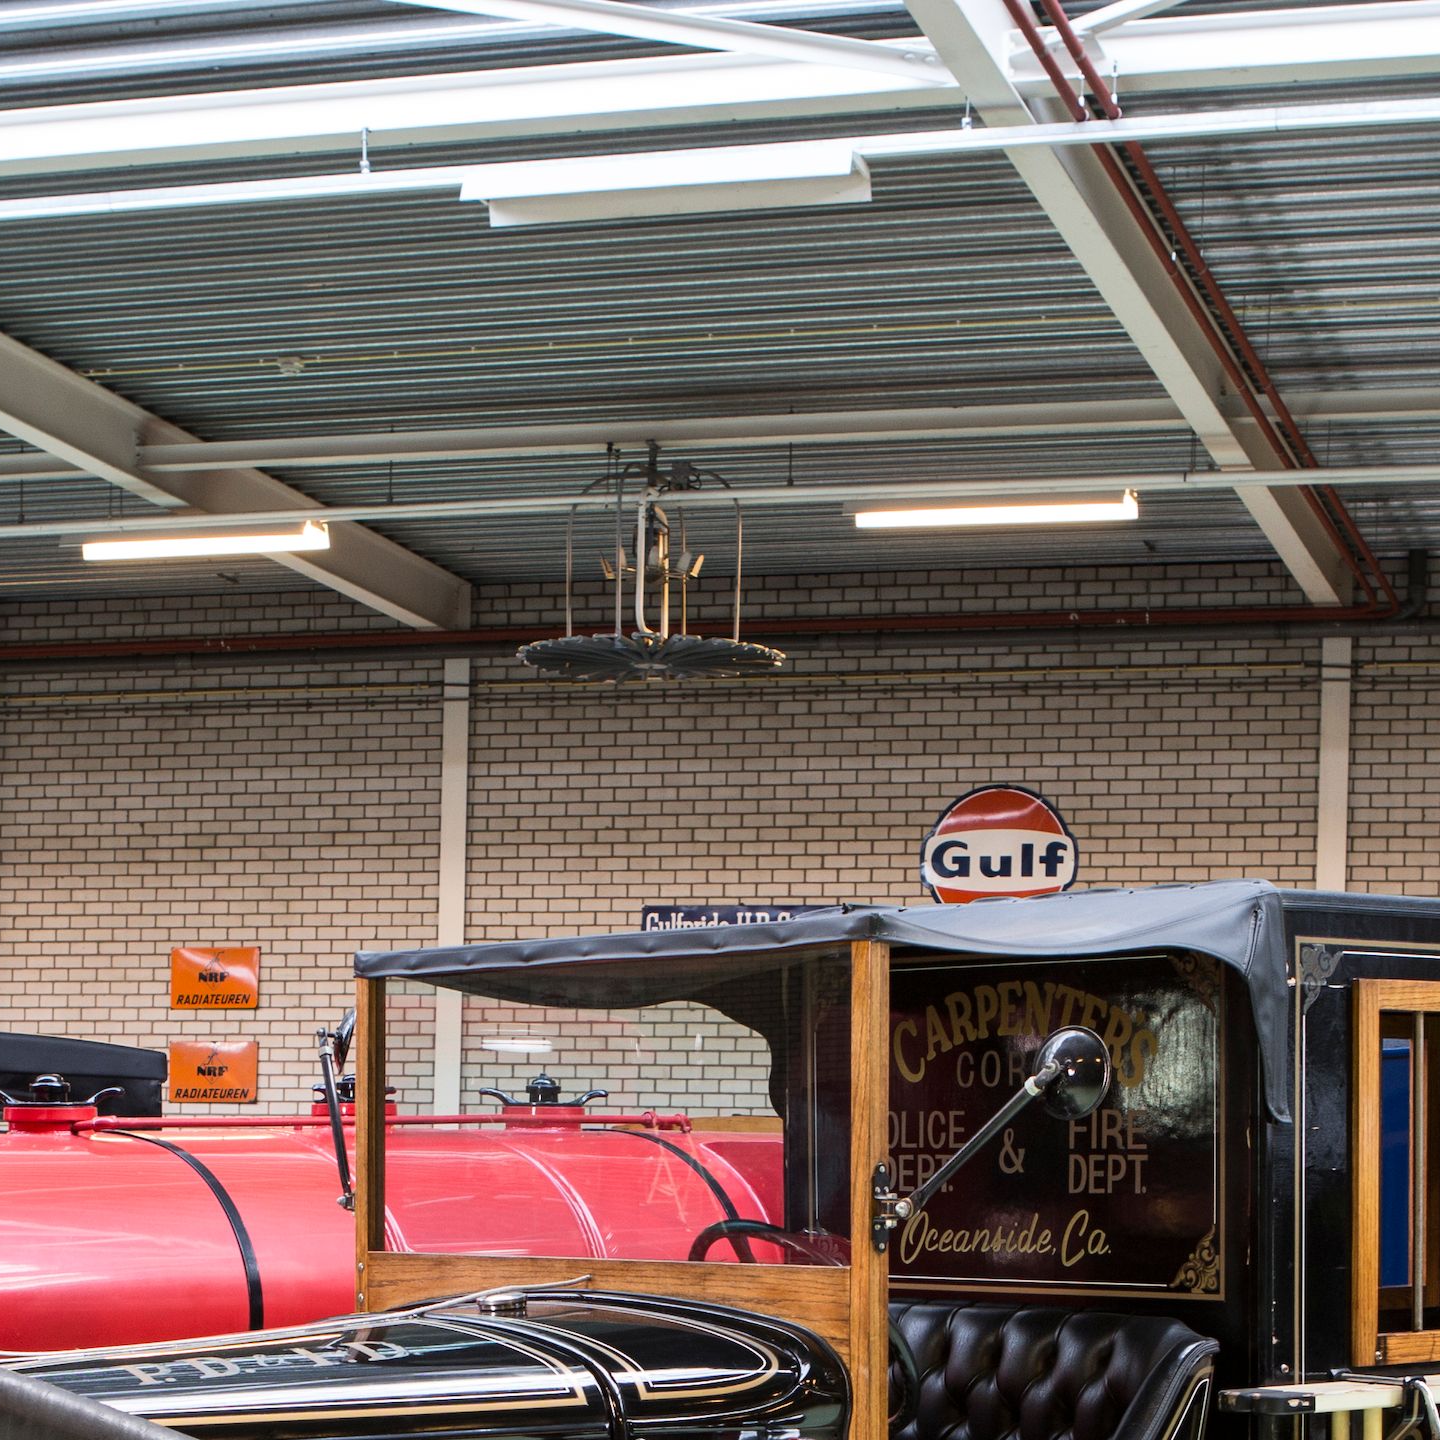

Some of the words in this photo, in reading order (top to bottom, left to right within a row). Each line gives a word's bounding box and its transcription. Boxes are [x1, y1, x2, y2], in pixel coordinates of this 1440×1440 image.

[931, 840, 1068, 879] Gulf
[198, 971, 229, 983] NRF
[176, 993, 250, 1006] RADIATEUREN
[196, 1065, 228, 1077] NRF
[175, 1088, 250, 1099] RADIATEUREN
[887, 1109, 966, 1150] OLICE
[998, 1128, 1026, 1174] &
[1068, 1109, 1148, 1150] FIRE
[1068, 1154, 1149, 1195] DEPT.
